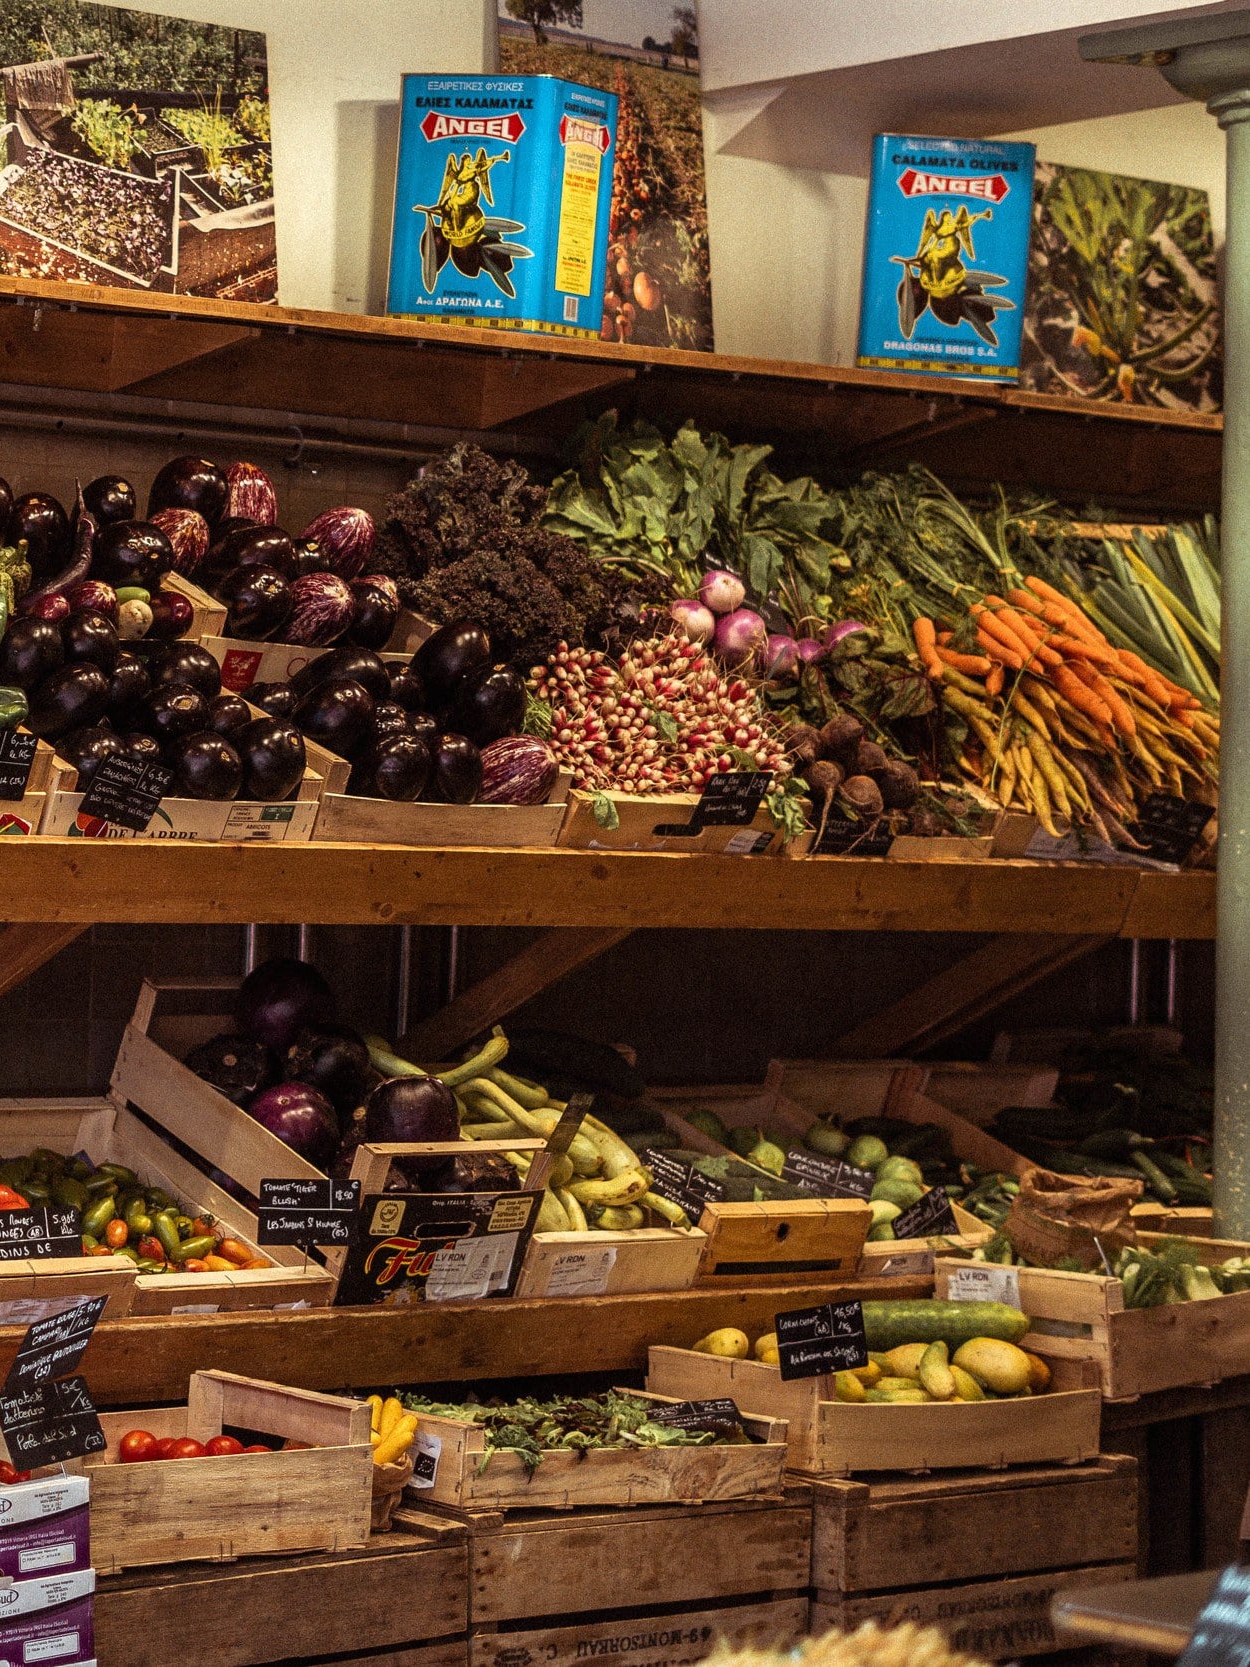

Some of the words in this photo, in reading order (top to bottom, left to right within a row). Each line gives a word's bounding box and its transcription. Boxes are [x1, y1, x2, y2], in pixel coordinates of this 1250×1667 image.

[433, 116, 514, 139] ANGEL
[892, 155, 964, 168] CALAMATA
[970, 159, 1018, 171] OLIVES
[910, 174, 997, 199] ANGEL
[883, 341, 942, 353] DRAGONAS
